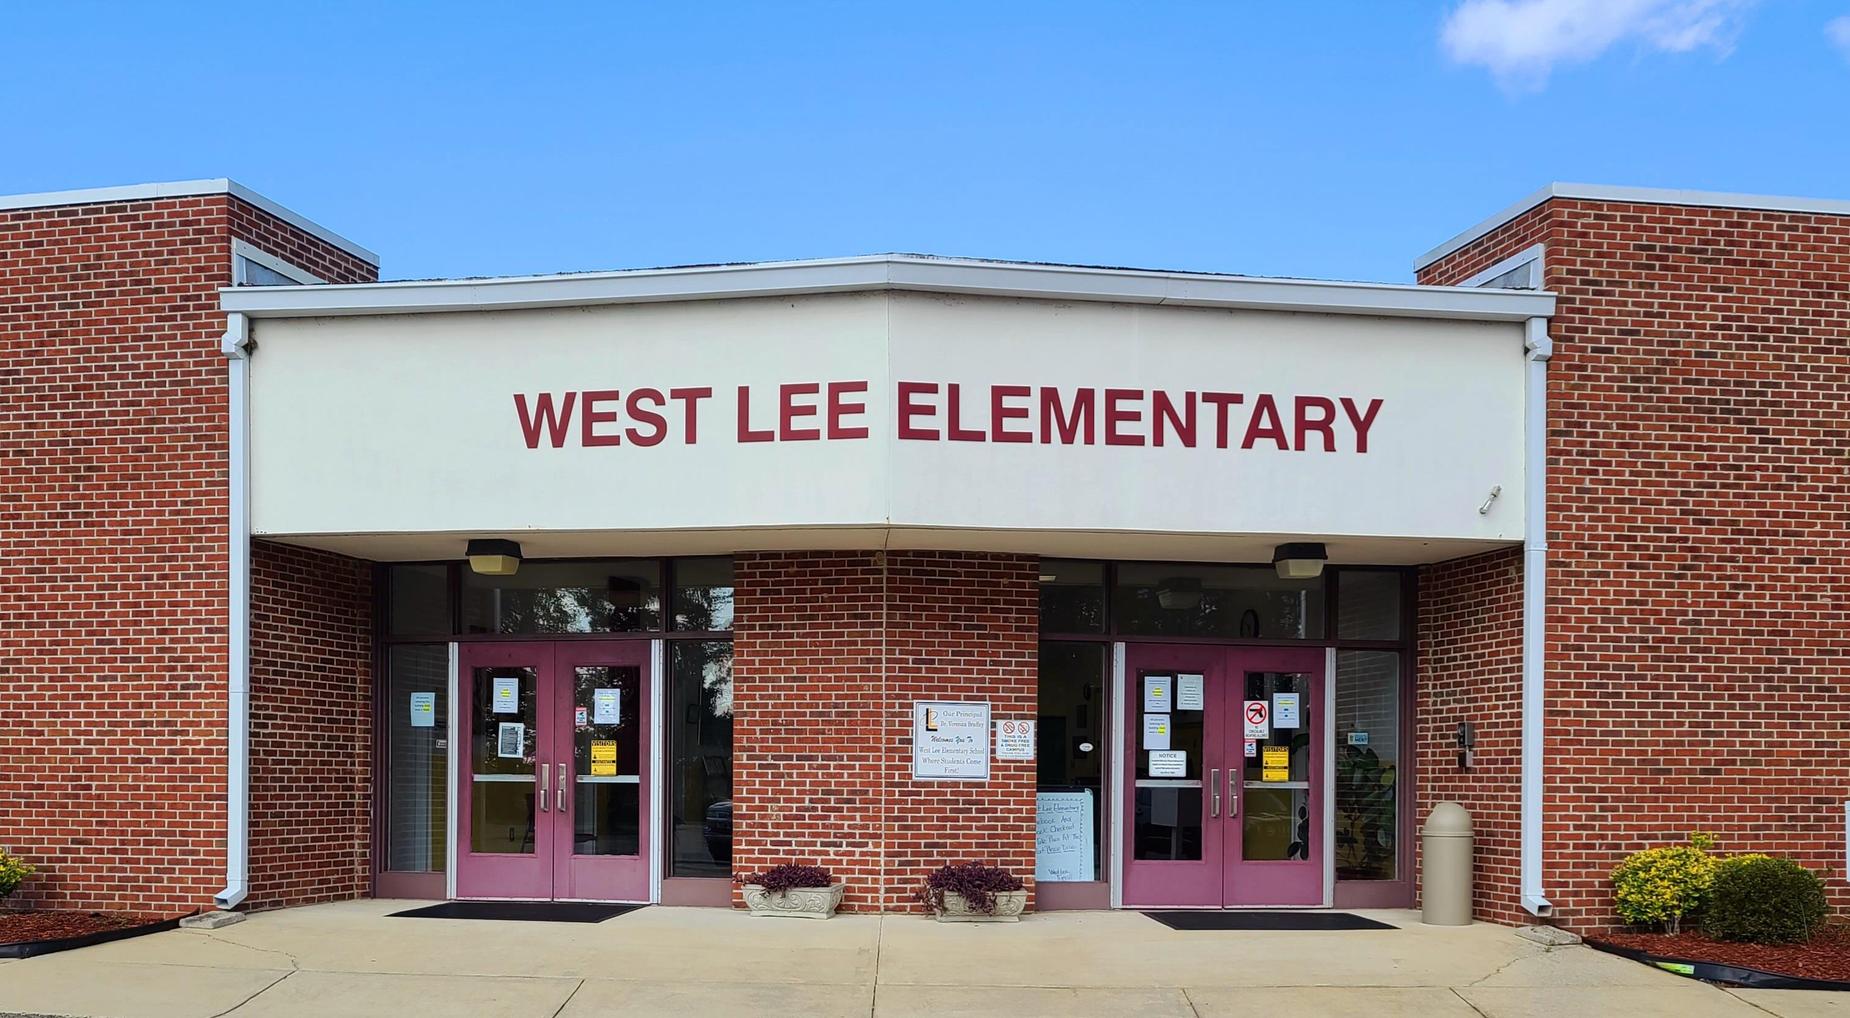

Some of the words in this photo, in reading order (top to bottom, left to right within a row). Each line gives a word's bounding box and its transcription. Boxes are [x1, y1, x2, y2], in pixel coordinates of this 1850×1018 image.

[513, 386, 712, 449] WEST
[737, 380, 868, 444] LEE
[898, 381, 1385, 454] ELEMENTARY
[955, 735, 965, 744] You
[966, 735, 974, 743] To
[931, 746, 941, 754] Lee
[941, 746, 969, 755] Elementary
[969, 746, 985, 754] School
[922, 756, 940, 764] Where
[965, 757, 982, 765] Come
